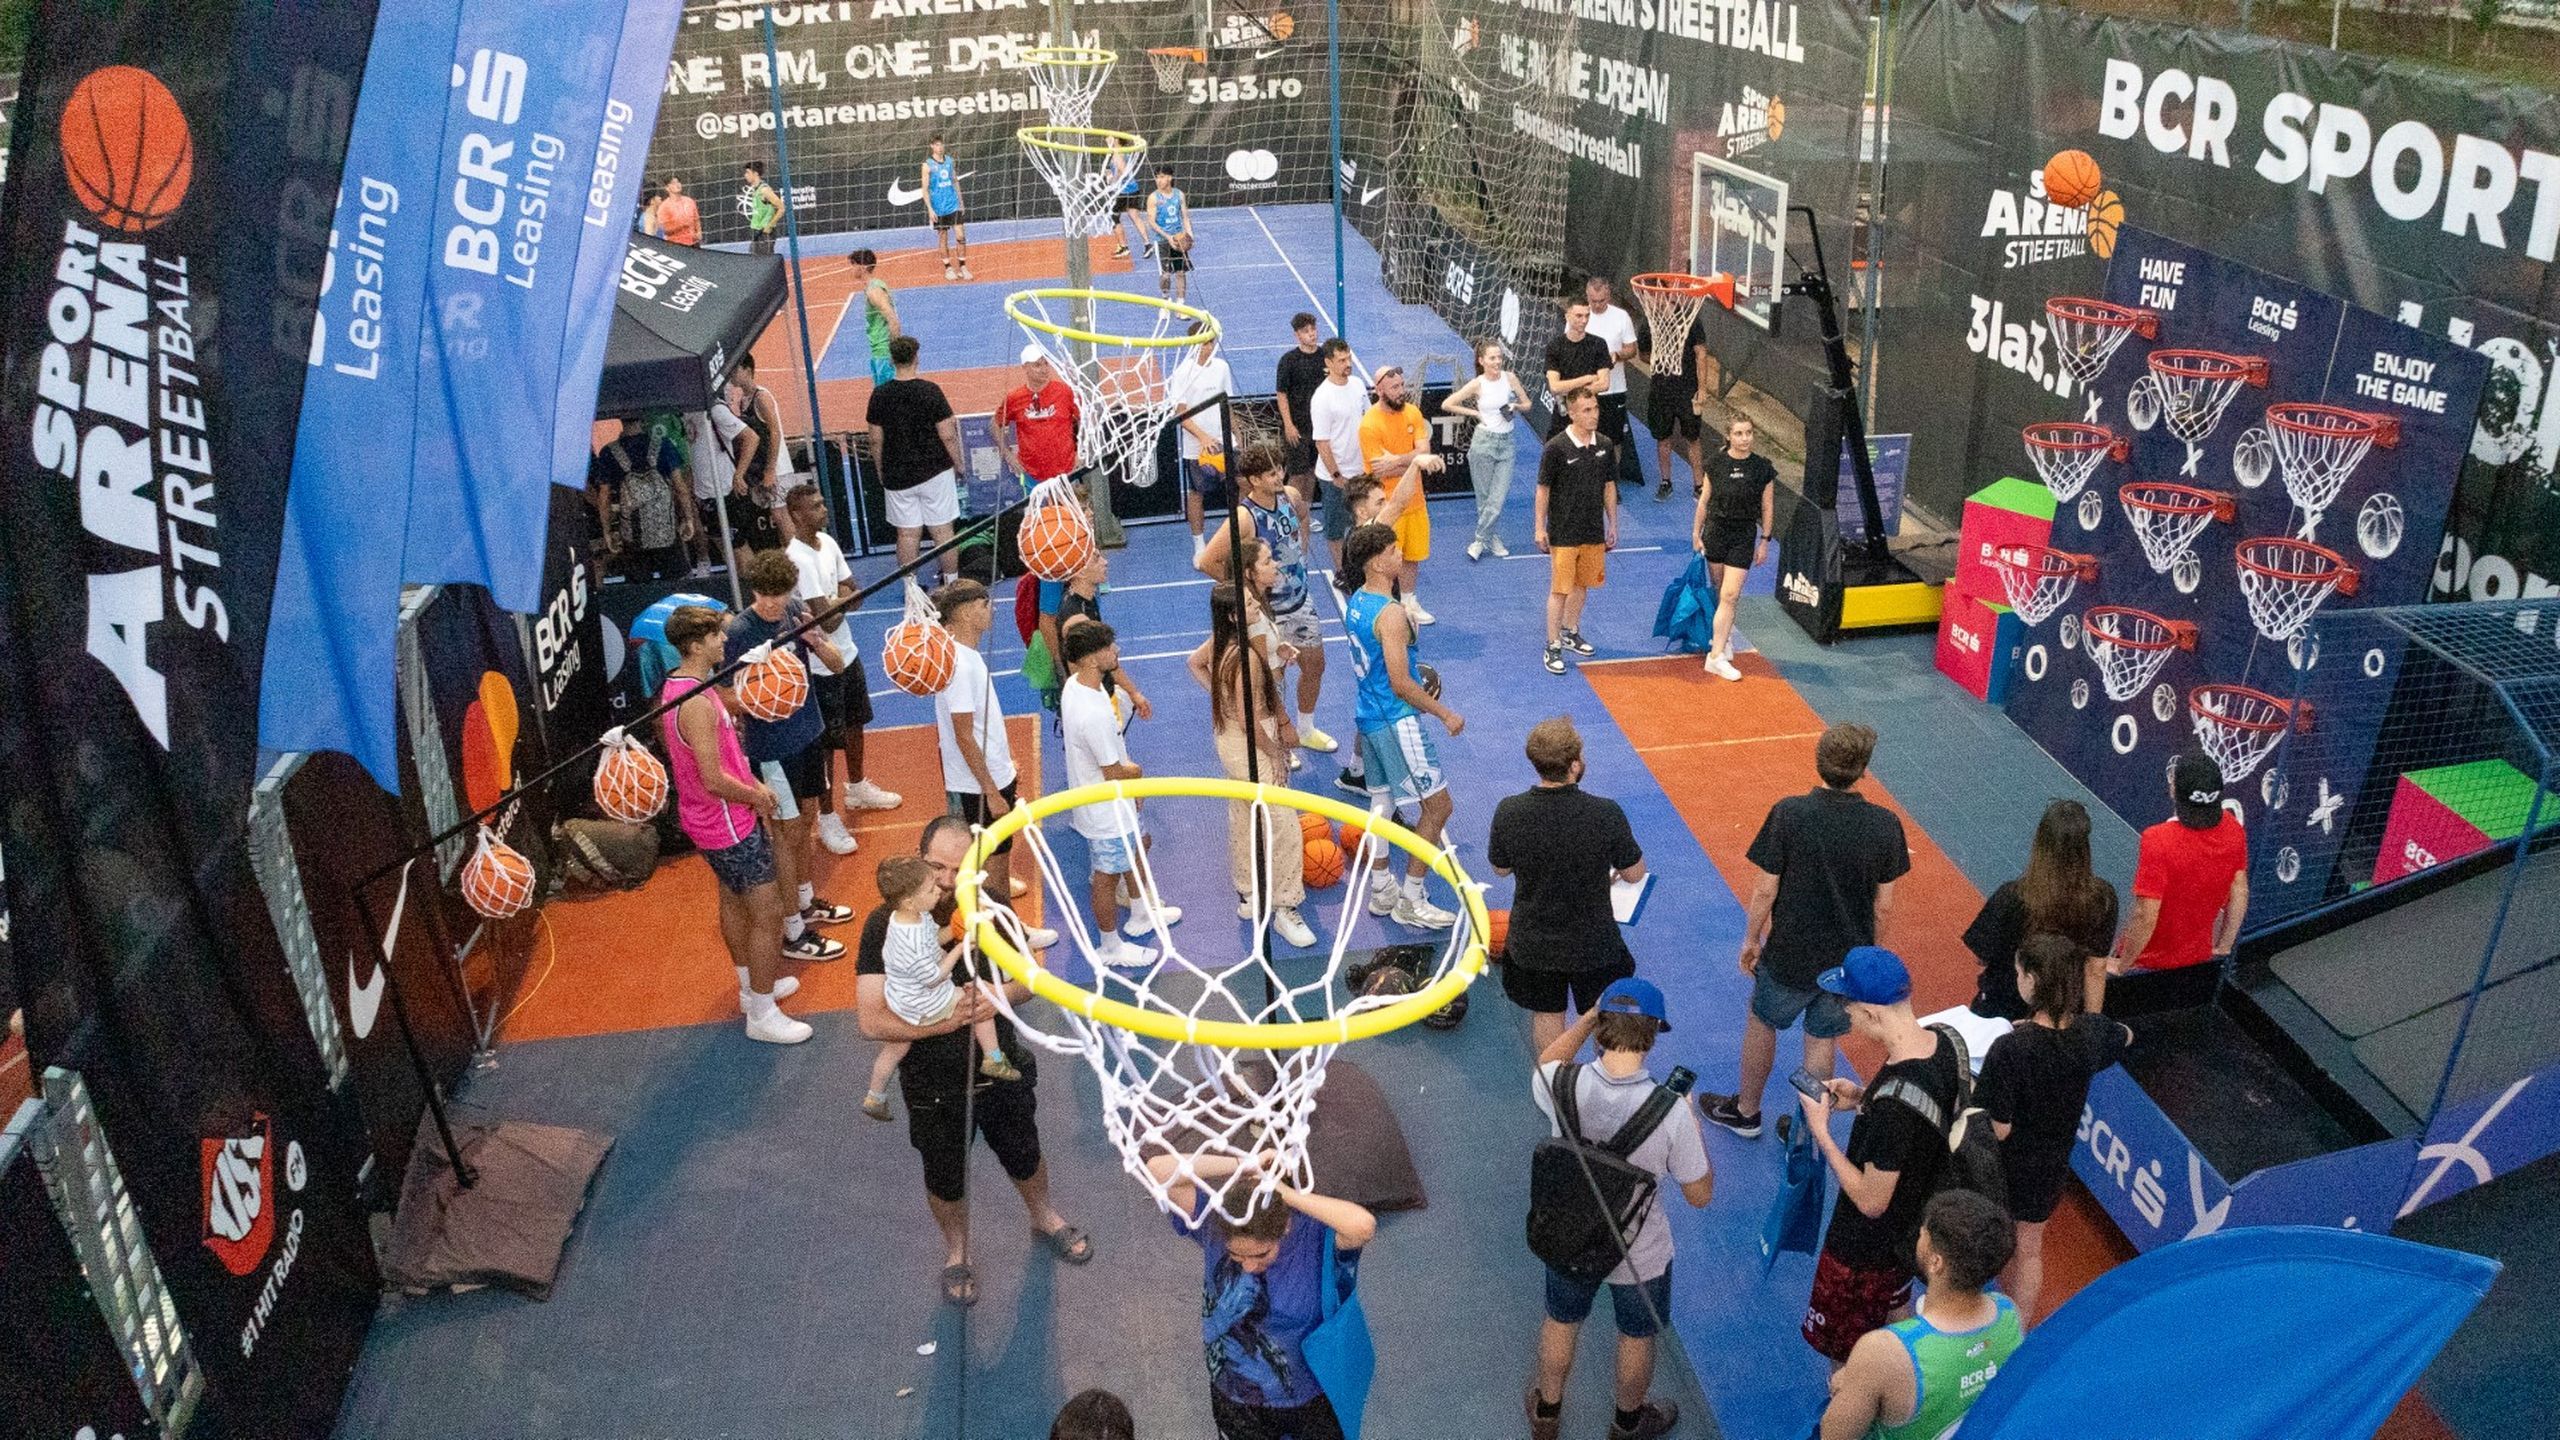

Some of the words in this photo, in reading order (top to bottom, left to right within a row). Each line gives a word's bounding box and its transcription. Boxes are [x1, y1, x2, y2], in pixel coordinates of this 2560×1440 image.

[664, 56, 726, 95] NE
[845, 40, 933, 80] ONE
[1186, 74, 1303, 105] 3la3.ro
[1594, 57, 1670, 125] DREAM
[583, 99, 634, 227] Leasing
[2098, 58, 2239, 169] BCR
[2254, 92, 2560, 263] SPORT
[444, 133, 514, 276] BCR
[505, 132, 566, 289] Leasing
[1980, 189, 2088, 237] ARENA
[334, 177, 399, 380] Leasing
[660, 274, 719, 313] Leasing
[2138, 257, 2187, 286] HAVE
[2139, 284, 2177, 311] FUN
[2248, 317, 2281, 342] Leasing
[2251, 296, 2283, 325] BCR
[32, 220, 100, 479] SPORT
[2373, 351, 2436, 384] ENJOY
[2355, 374, 2390, 402] THE
[2391, 383, 2448, 414] GAME
[154, 255, 231, 643] STREETBALL
[79, 242, 170, 752] ARENA
[1272, 516, 1292, 540] 18
[535, 588, 573, 674] BCR
[542, 639, 582, 712] Leasing
[241, 1317, 260, 1359] #1
[254, 1275, 279, 1328] HIT
[272, 1208, 304, 1288] RADIO
[1960, 1368, 1985, 1389] BCR
